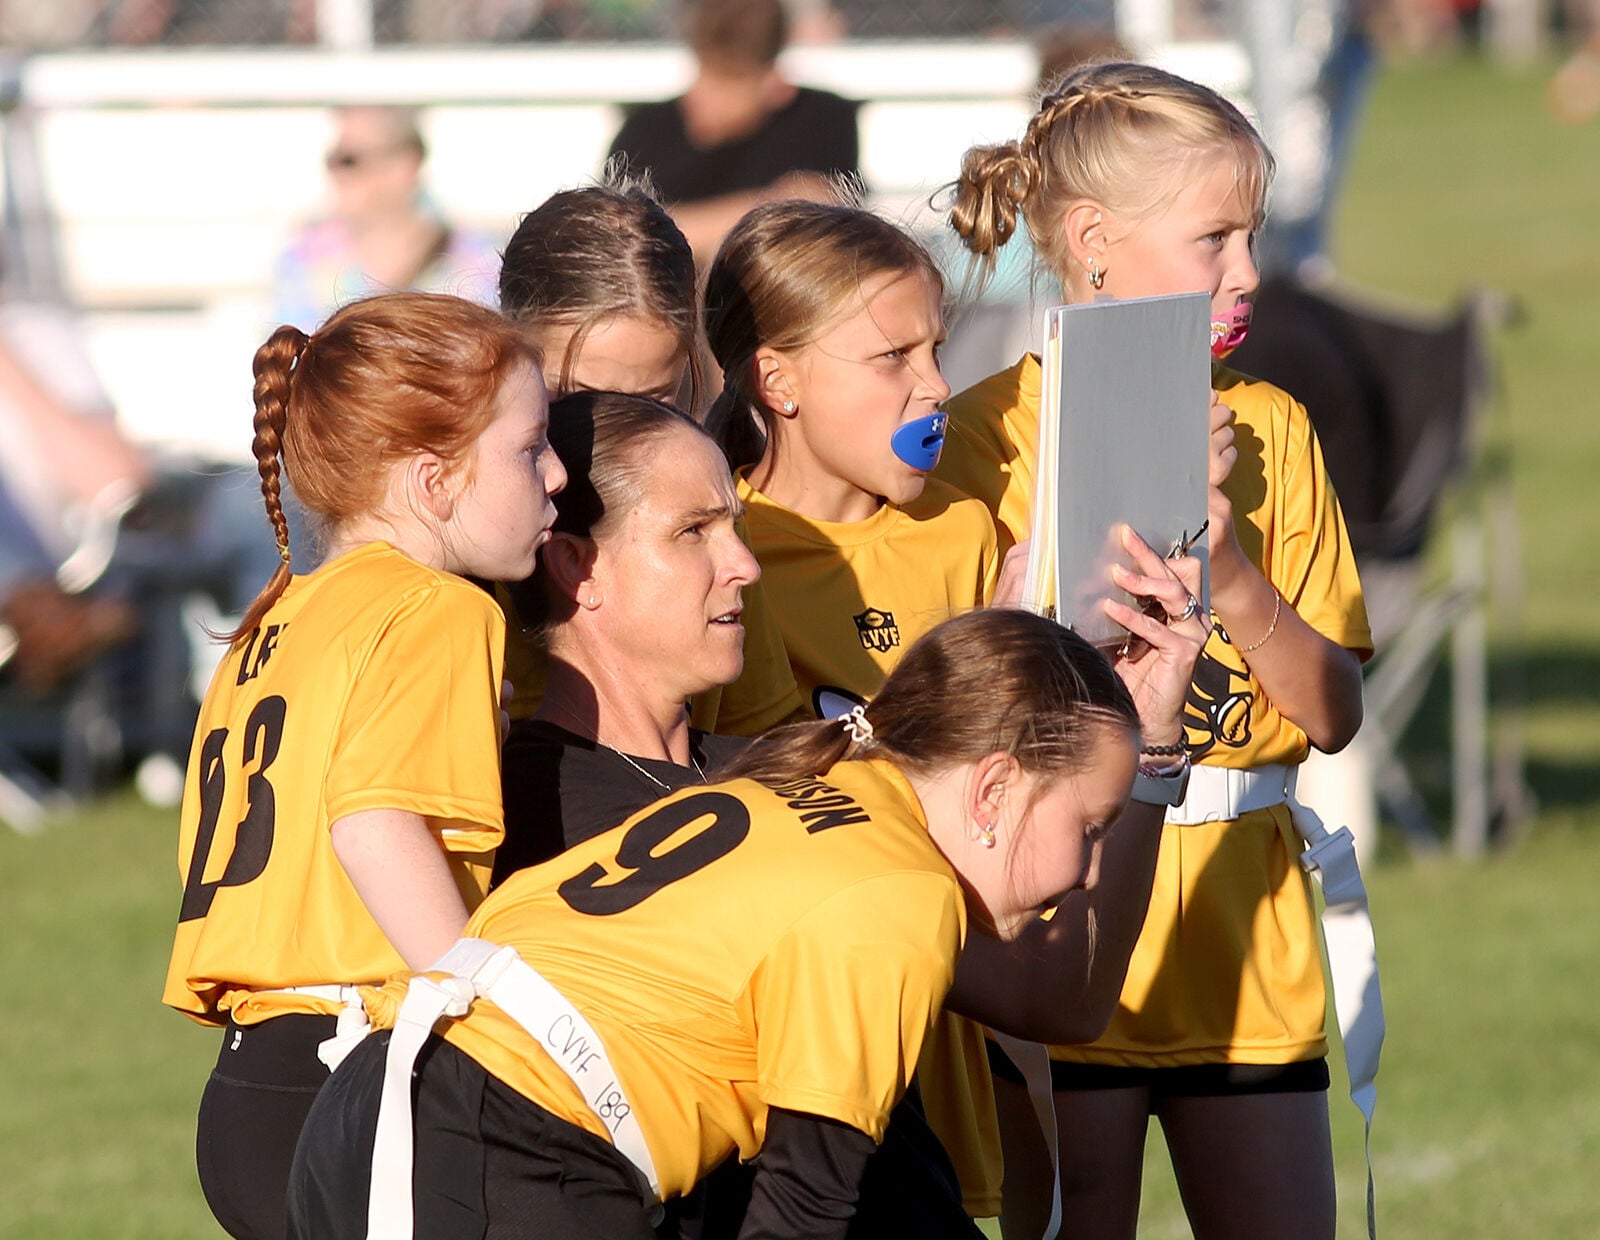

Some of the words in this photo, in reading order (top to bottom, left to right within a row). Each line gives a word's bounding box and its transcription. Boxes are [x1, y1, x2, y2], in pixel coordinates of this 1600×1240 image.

[859, 626, 899, 649] CVYF
[773, 775, 872, 835] SON
[556, 791, 751, 917] 9
[547, 1013, 601, 1074] CVYF
[594, 1080, 631, 1134] 189
